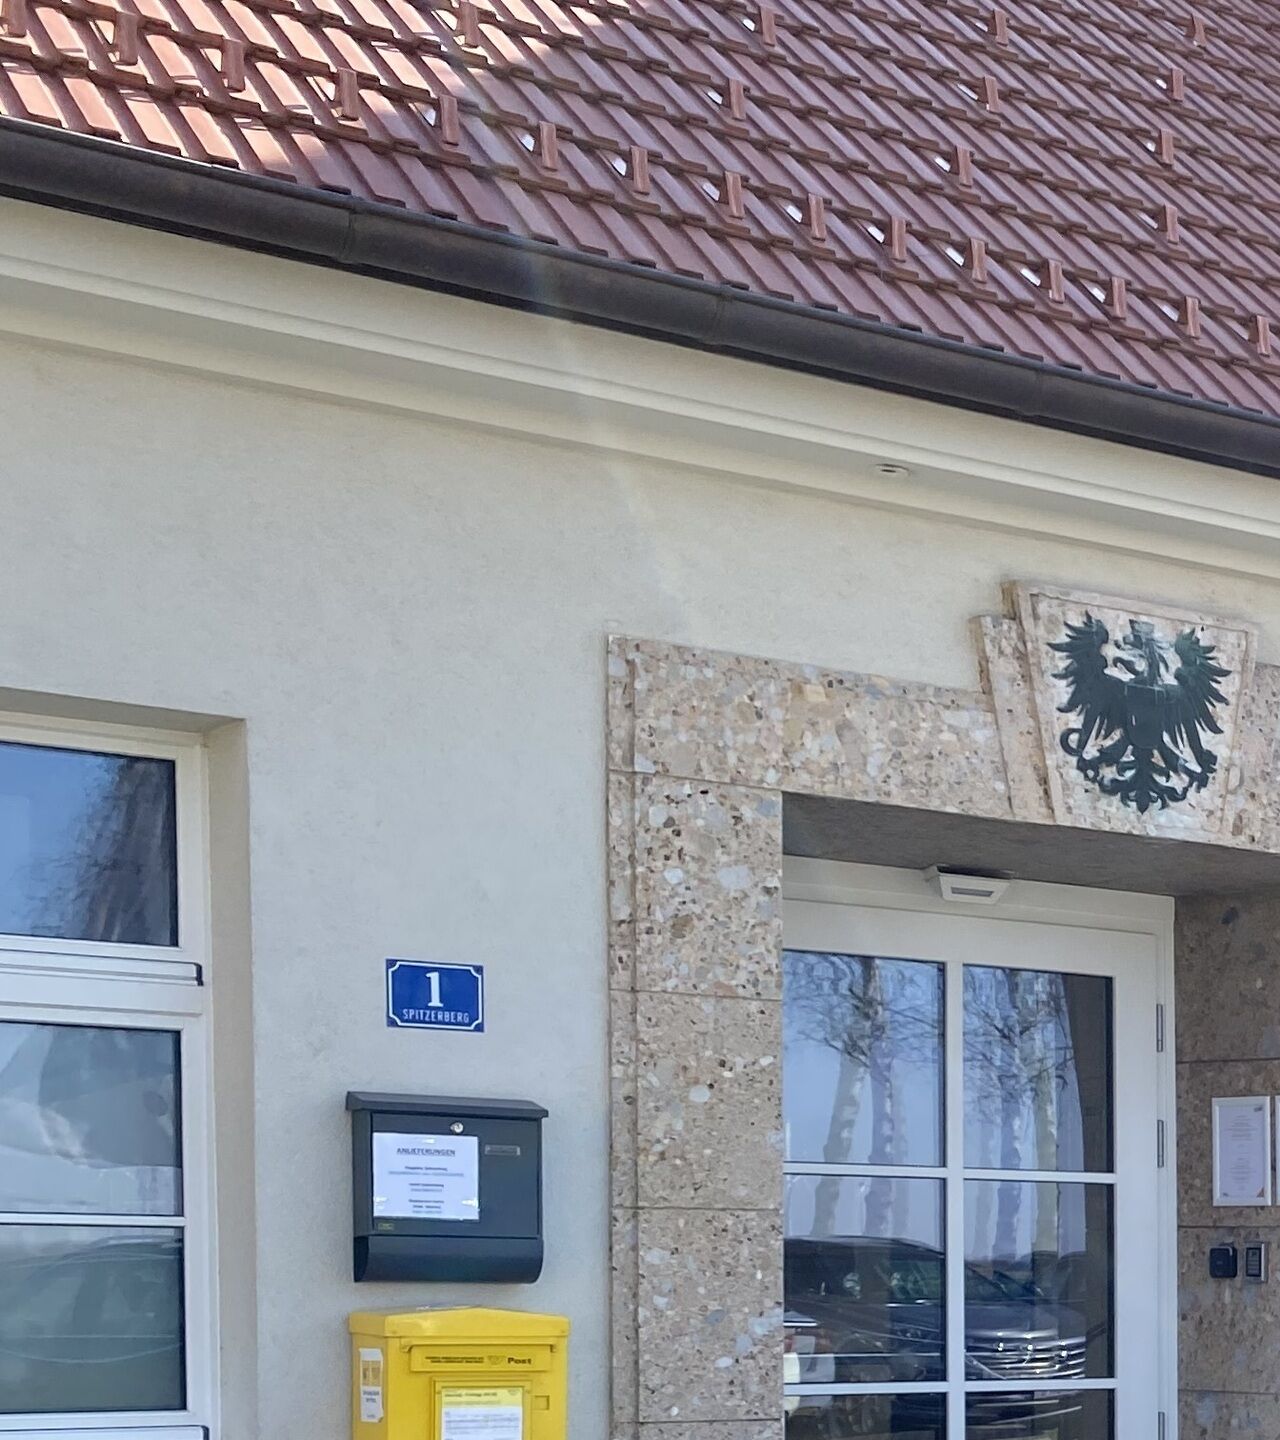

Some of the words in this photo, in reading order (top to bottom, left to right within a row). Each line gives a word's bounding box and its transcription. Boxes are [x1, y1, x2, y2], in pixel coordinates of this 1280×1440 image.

[425, 971, 443, 1007] 1
[402, 1008, 469, 1024] SPITZERBERG
[507, 1357, 532, 1365] Post
